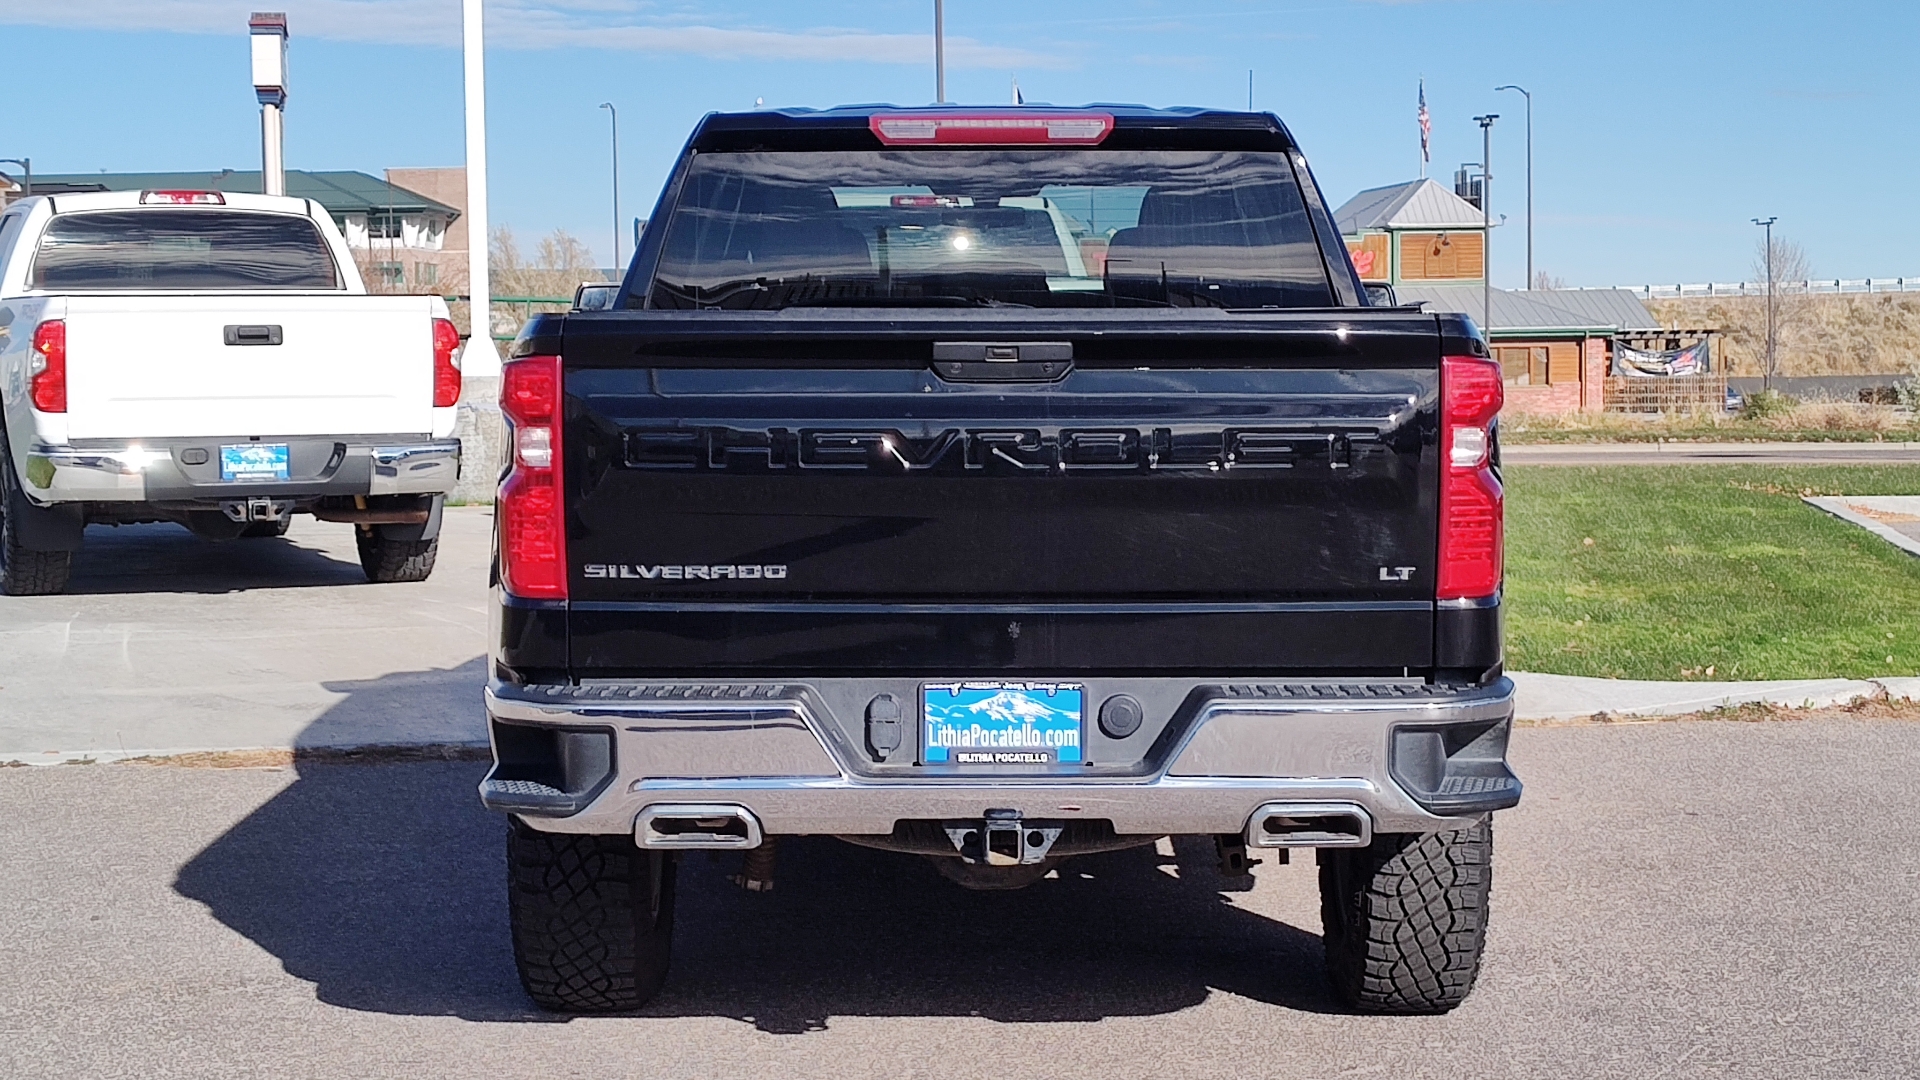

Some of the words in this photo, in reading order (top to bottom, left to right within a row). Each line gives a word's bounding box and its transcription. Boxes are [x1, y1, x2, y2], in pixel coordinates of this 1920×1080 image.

[622, 427, 1381, 469] CHEVROLET
[583, 564, 788, 580] SILVERADO
[1379, 566, 1417, 581] LT
[928, 723, 1079, 747] LithiaPocatello.com
[995, 753, 1048, 763] POCATELLO
